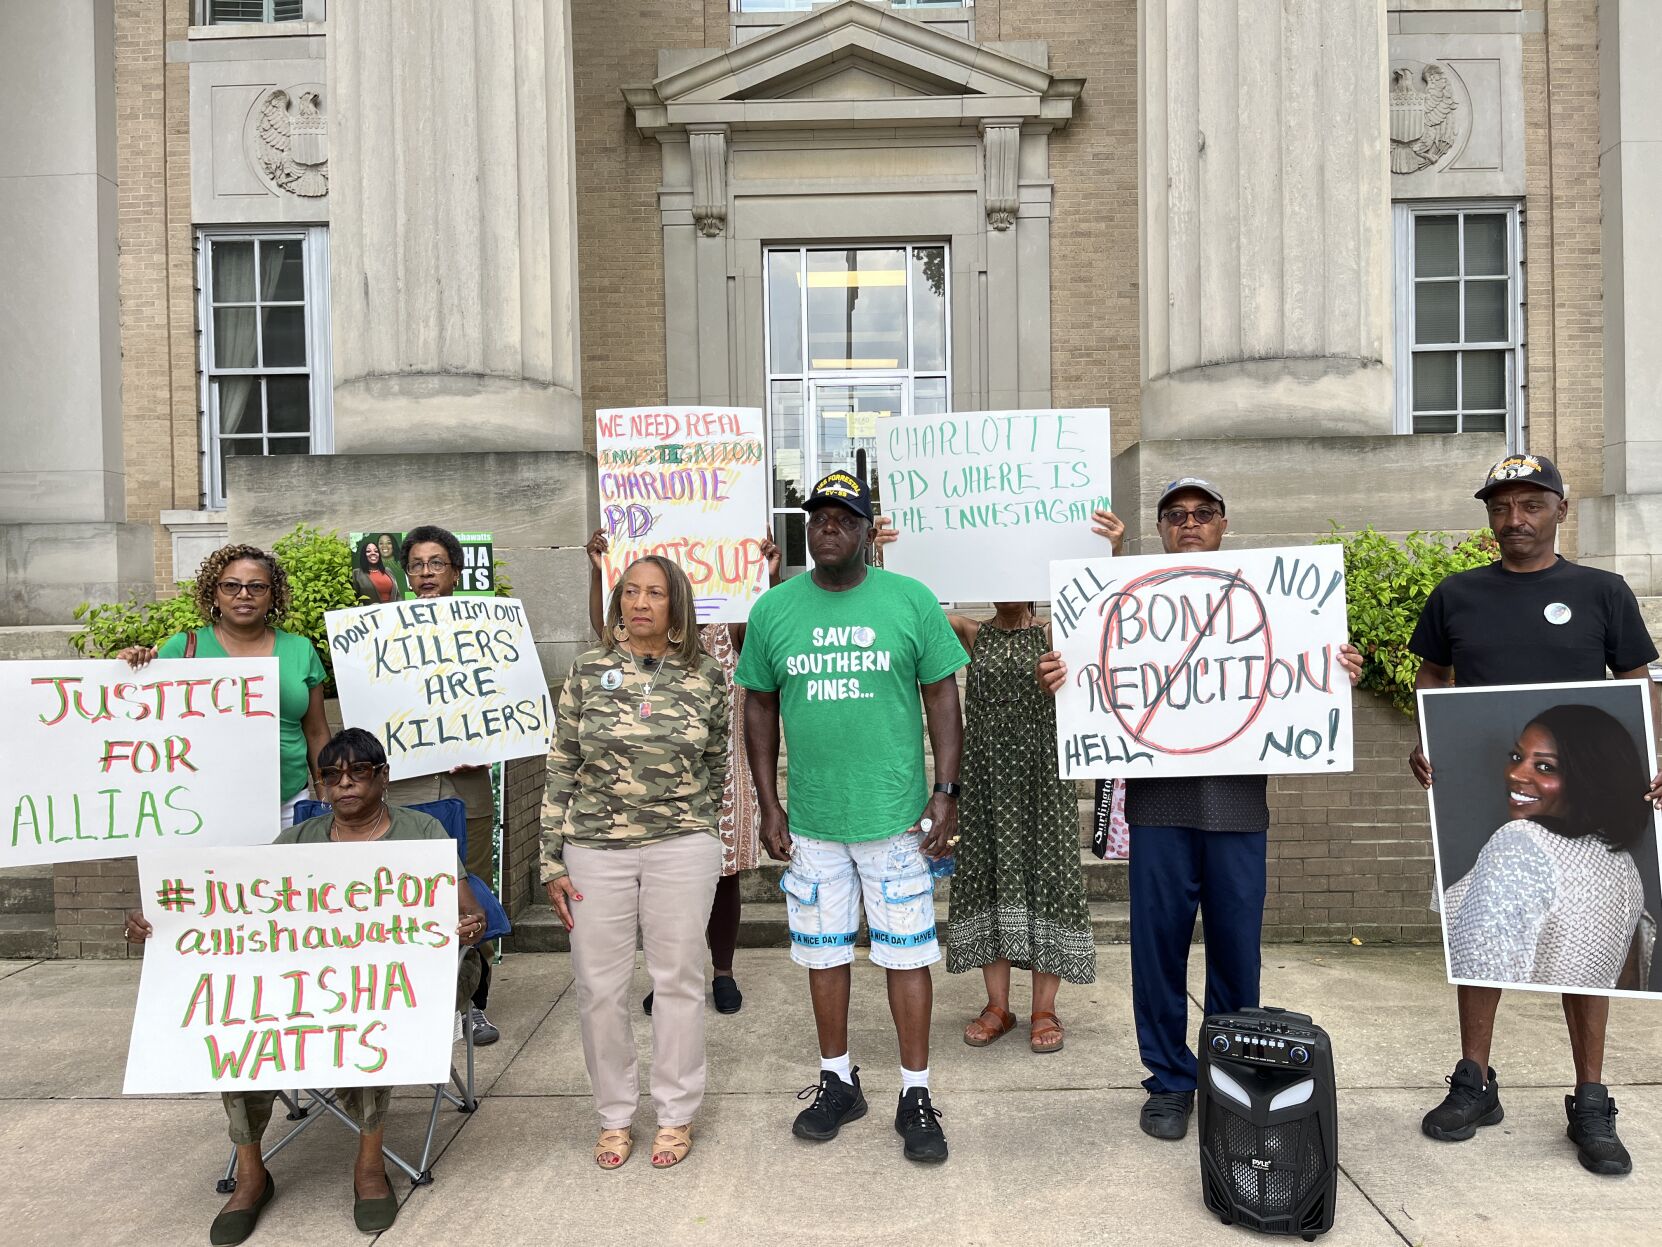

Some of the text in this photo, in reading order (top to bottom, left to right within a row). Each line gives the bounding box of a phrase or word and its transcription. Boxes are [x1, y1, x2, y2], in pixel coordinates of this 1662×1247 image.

[598, 412, 754, 441] WE NEED REAL
[889, 416, 1086, 461] CHARLOTTE
[600, 467, 730, 501] CHARLOTTE
[888, 461, 1090, 502] PD WHERE IS
[604, 504, 654, 538] PD
[884, 507, 934, 534] THE
[1053, 567, 1117, 638] HELL
[1266, 556, 1343, 615] NO!
[333, 609, 381, 654] DON'T
[397, 603, 439, 630] LET
[494, 604, 523, 627] OUT
[1099, 583, 1265, 649] BOND
[373, 629, 519, 678] KILLERS
[786, 650, 890, 676] SOUTHERN
[424, 667, 497, 705] ARE
[807, 678, 874, 701] PINES...
[1077, 644, 1333, 713] REDUCTION
[31, 676, 276, 727] JUSTICE
[385, 694, 550, 756] KILLERS!
[1259, 708, 1340, 765] NO!
[98, 735, 199, 774] FOR
[1064, 733, 1155, 776] HELL
[12, 785, 204, 847] ALLIAS
[156, 866, 457, 918] #justicefor
[175, 915, 450, 956] allishawatts
[822, 936, 838, 944] DAY
[874, 931, 889, 943] NICE
[891, 936, 907, 946] DAY
[913, 930, 932, 944] HAVE
[181, 961, 417, 1028] ALLISHA
[204, 1020, 388, 1080] WATTS
